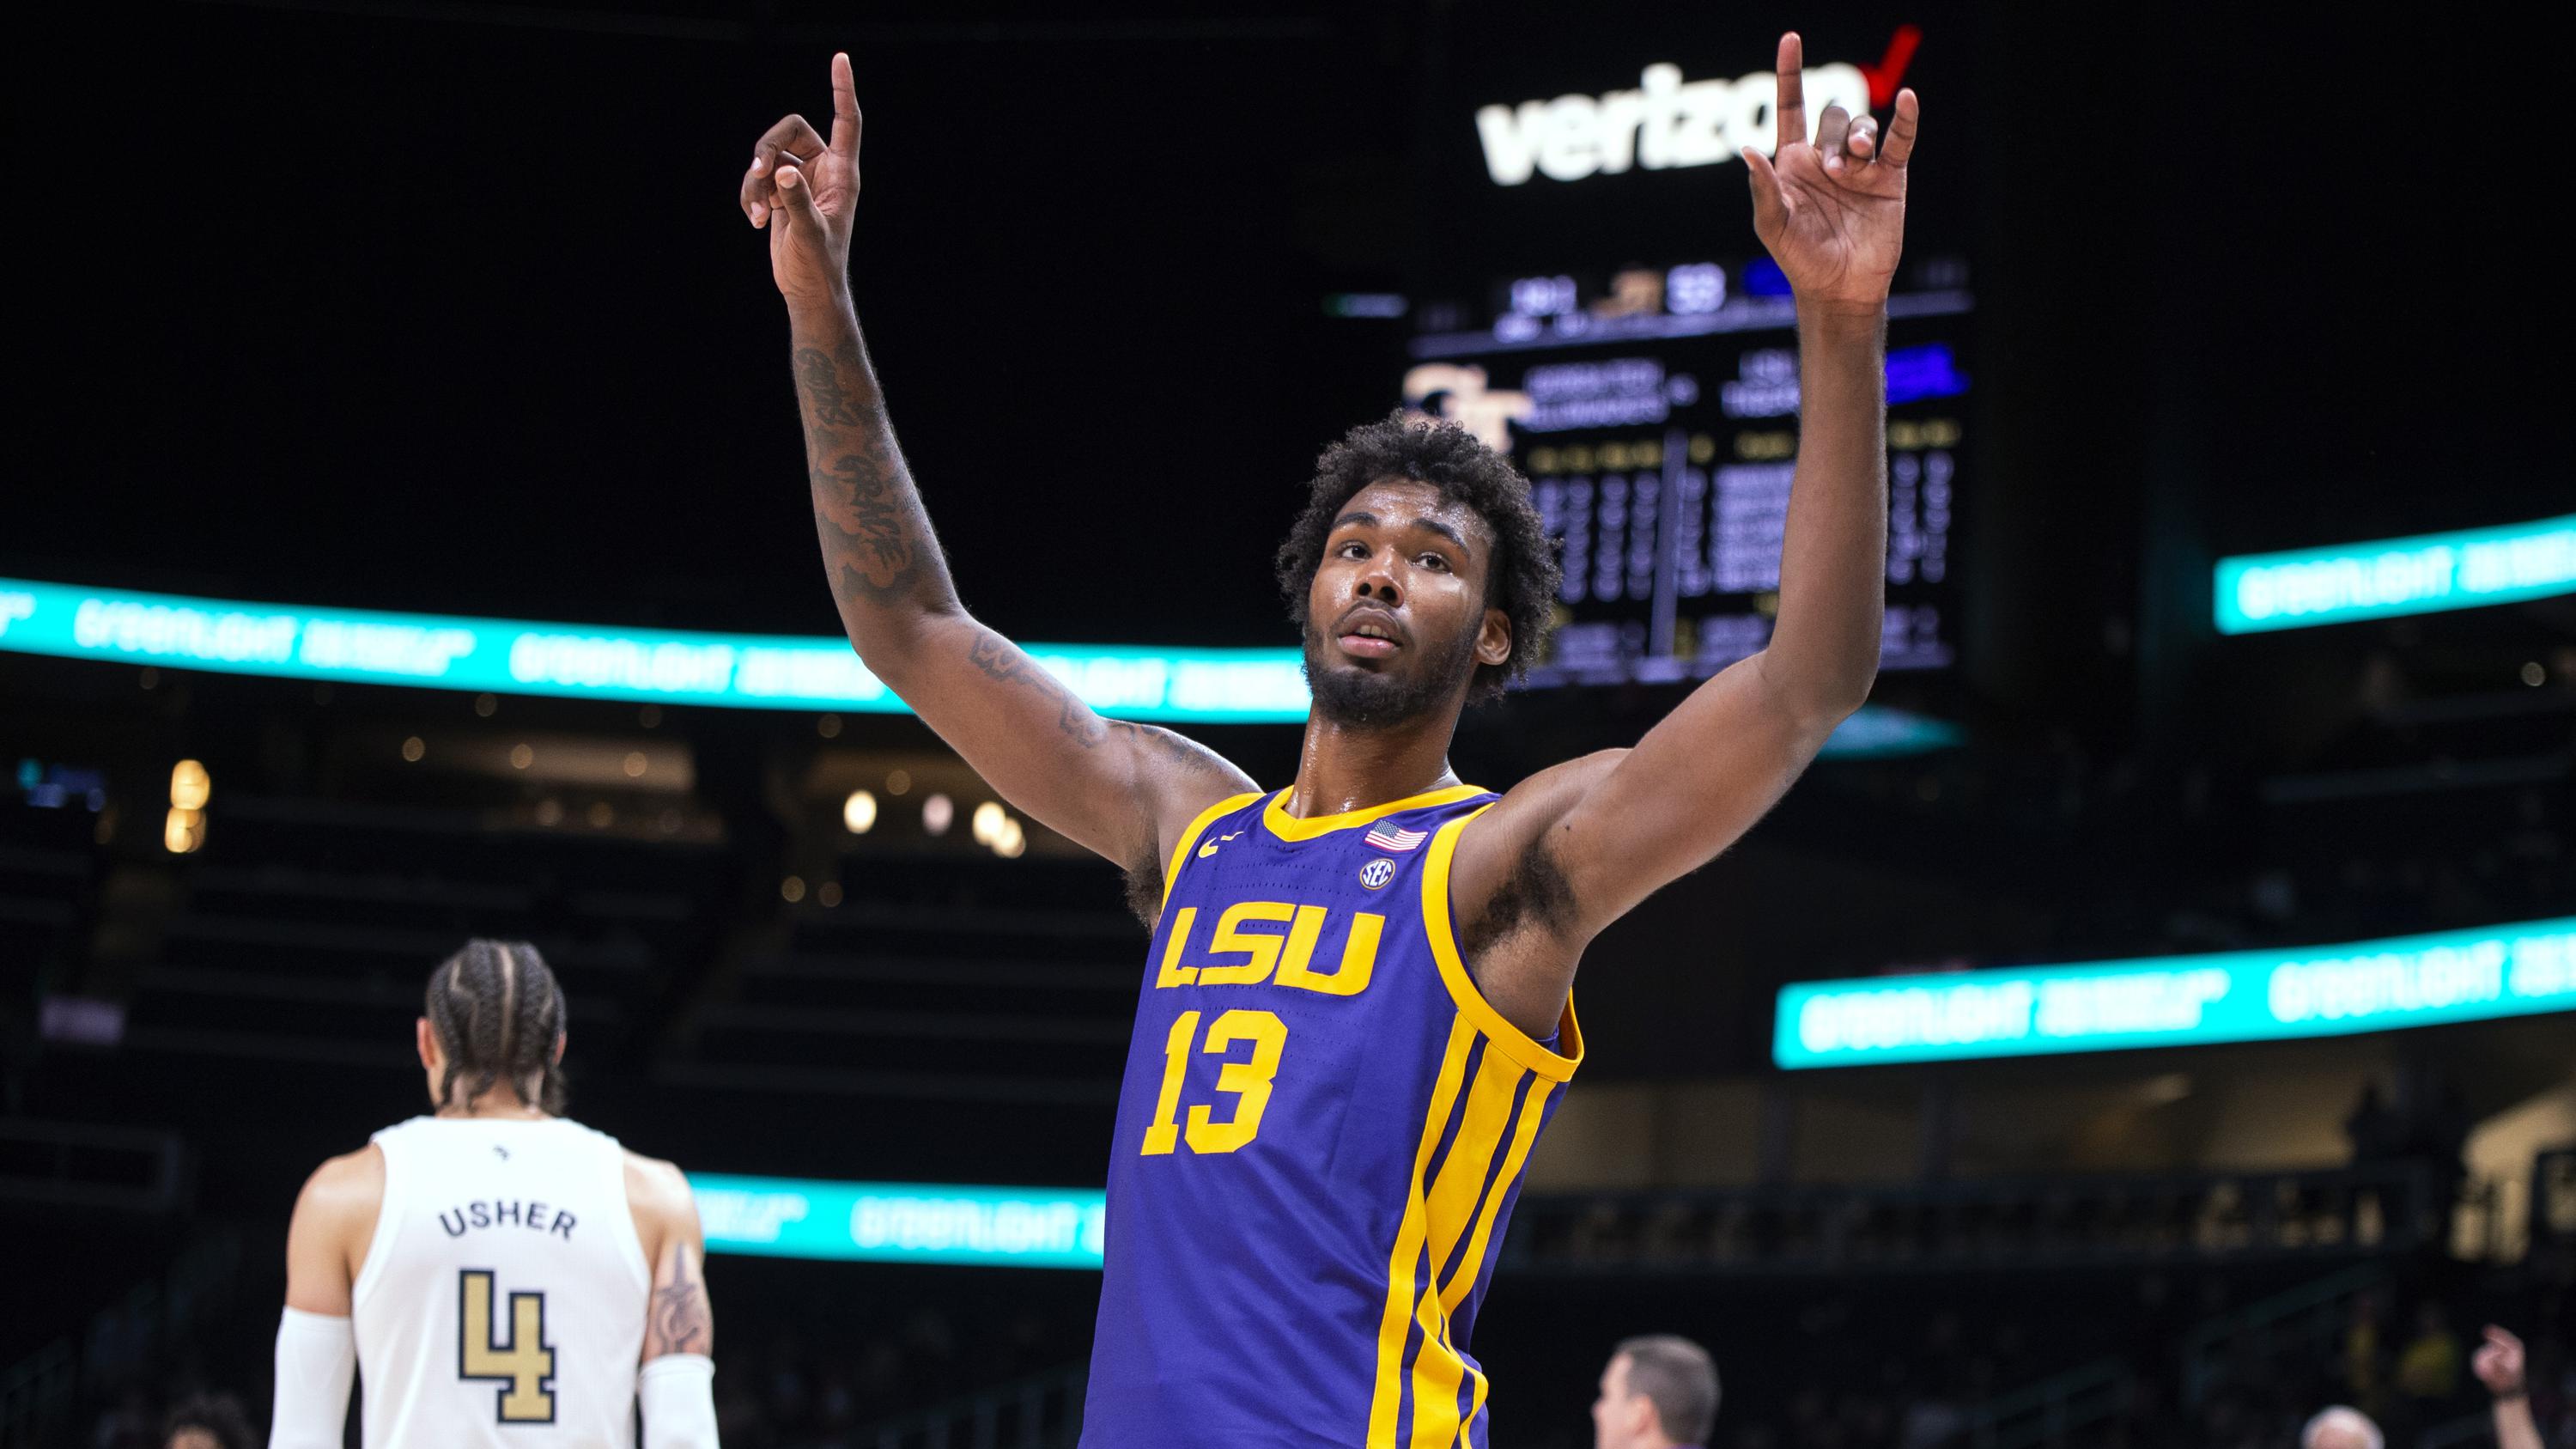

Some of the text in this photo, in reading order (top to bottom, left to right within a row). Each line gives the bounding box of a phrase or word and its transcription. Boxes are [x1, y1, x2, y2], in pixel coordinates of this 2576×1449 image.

[1476, 62, 1870, 186] verizon
[1363, 861, 1392, 886] SEC
[1156, 902, 1386, 995] LSU
[1140, 1010, 1289, 1156] 13
[439, 1200, 578, 1241] USHER
[458, 1269, 556, 1424] 4
